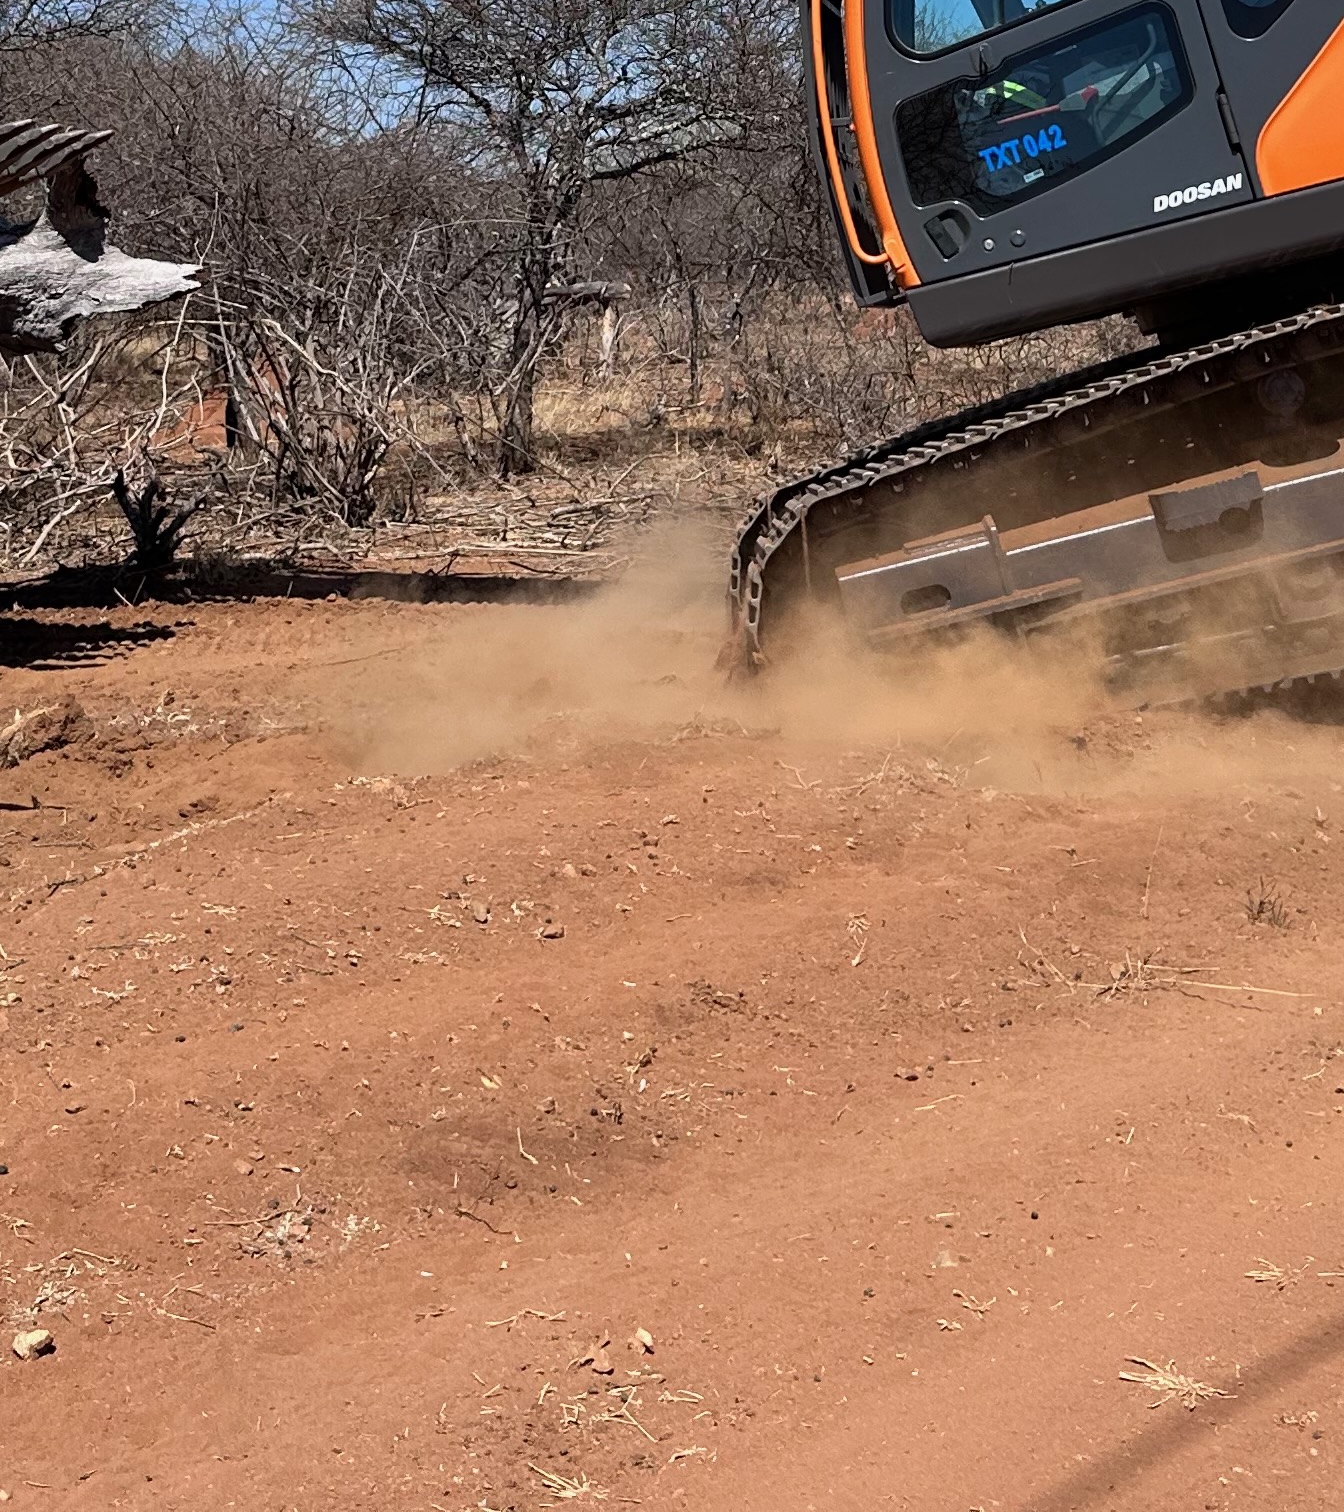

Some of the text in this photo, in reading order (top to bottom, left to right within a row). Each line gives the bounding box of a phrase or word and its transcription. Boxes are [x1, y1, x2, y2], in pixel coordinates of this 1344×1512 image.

[978, 124, 1067, 173] TXT 042
[1153, 172, 1243, 213] DOOSAN
